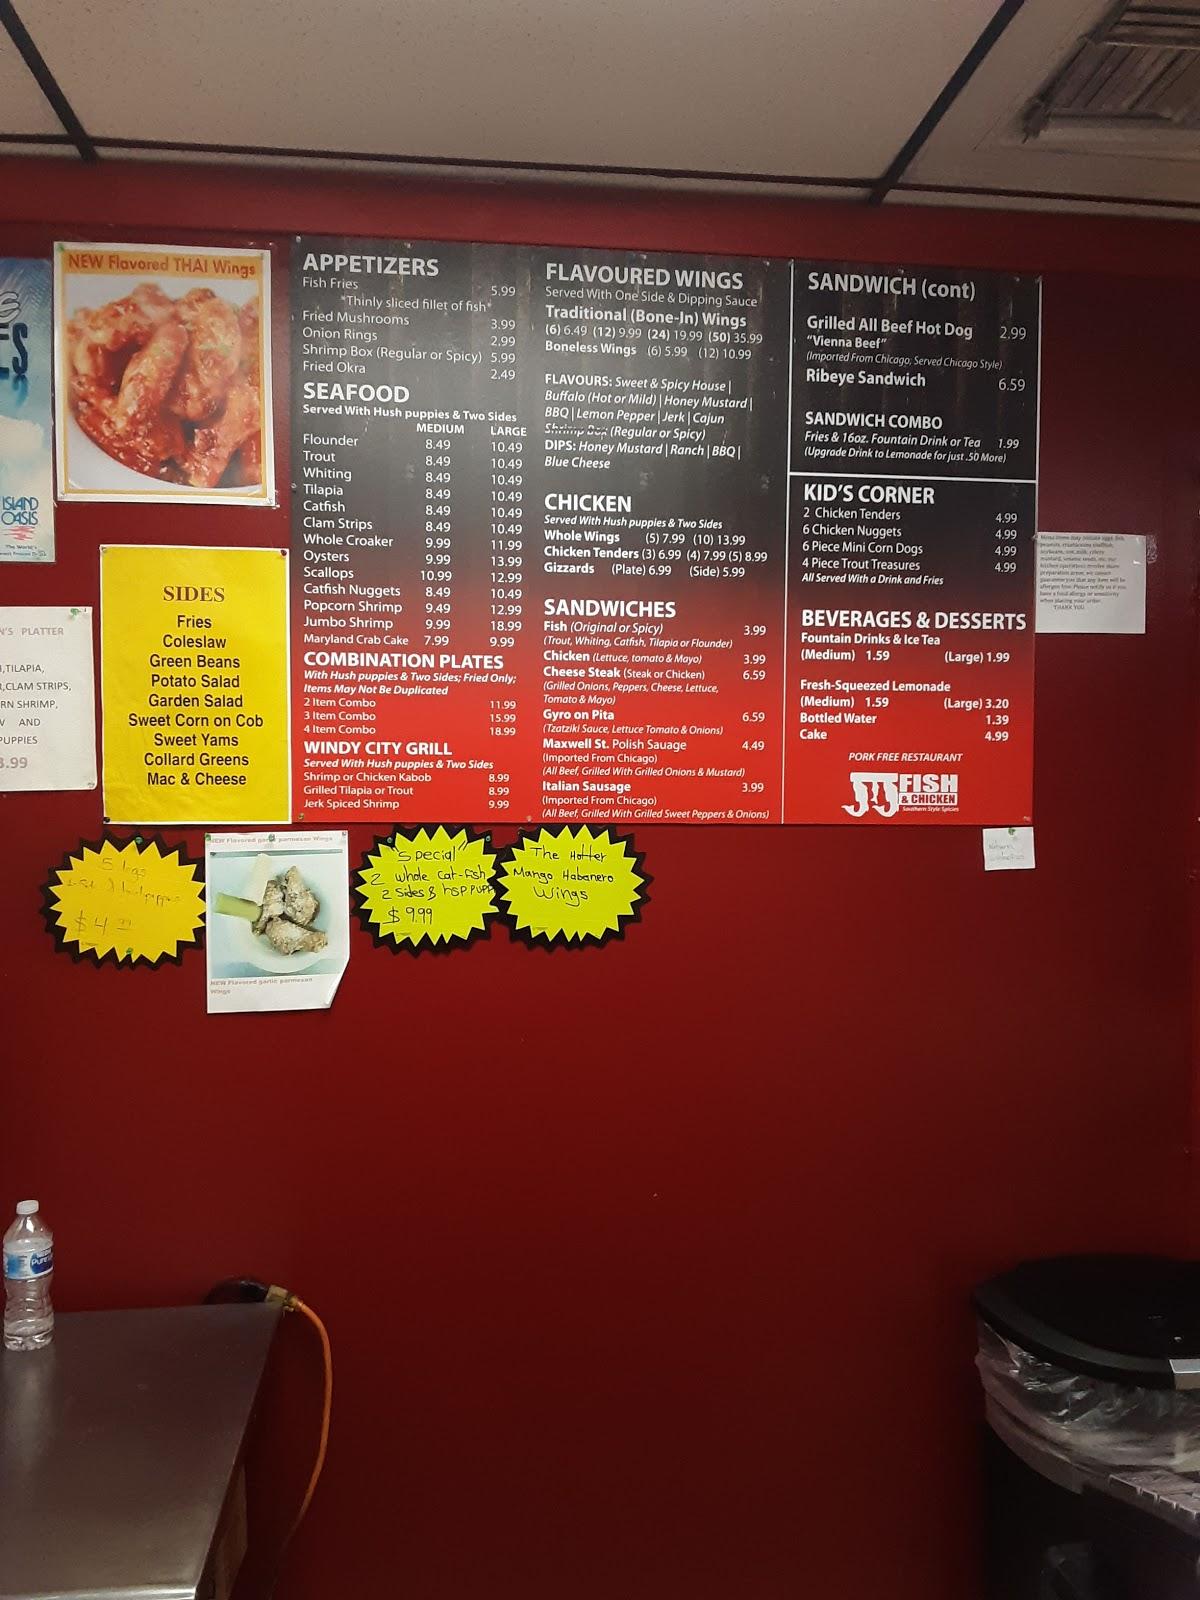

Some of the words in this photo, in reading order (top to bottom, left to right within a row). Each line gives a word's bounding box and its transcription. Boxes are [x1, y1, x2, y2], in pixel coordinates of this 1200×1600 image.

[68, 254, 102, 268] NEW
[108, 256, 168, 271] Flavored
[173, 258, 208, 273] THAI
[212, 259, 256, 278] Wings
[303, 254, 438, 276] APPETIZERS
[547, 263, 670, 286] FLAVOURED
[675, 270, 743, 289] WINGS
[303, 277, 326, 288] Fish
[331, 278, 358, 289] Fries
[492, 286, 515, 296] 5.99
[808, 272, 916, 297] SANDWICH
[922, 279, 975, 301] (cont)
[386, 297, 418, 309] sliced
[423, 299, 448, 310] fillet
[451, 300, 463, 311] of
[546, 305, 626, 321] Traditional
[631, 309, 698, 326] (Bone-In)
[702, 312, 746, 330] Wings
[807, 316, 855, 330] Grilled
[859, 318, 877, 331] All
[882, 319, 913, 333] Beef
[916, 321, 941, 335] Hot
[945, 323, 972, 339] Dog
[1000, 326, 1026, 340] 2.99
[546, 340, 598, 353] Boneless
[601, 343, 636, 357] Wings
[648, 346, 661, 357] (6)
[665, 346, 687, 357] 5.99
[699, 347, 718, 360] (12)
[723, 348, 751, 360] 10.99
[807, 368, 854, 386] Ribeye
[858, 371, 925, 386] Sandwich
[999, 378, 1025, 391] 6.59
[304, 382, 409, 402] SEAFOOD
[806, 412, 885, 427] SANDWICH
[888, 415, 942, 429] COMBO
[417, 423, 464, 434] MEDIUM
[491, 426, 526, 436] LARGE
[304, 434, 358, 446] Flounder
[426, 439, 450, 450] 8.49
[492, 442, 522, 452] 10.49
[805, 484, 853, 502] KID'S
[858, 486, 934, 504] CORNER
[3, 496, 39, 510] ISLAND
[545, 494, 631, 512] CHICKEN
[1, 511, 38, 525] OASIS
[544, 530, 582, 541] Whole
[584, 531, 620, 544] Wings
[646, 533, 659, 544] (5)
[663, 534, 685, 544] 7.99
[694, 534, 713, 545] (10)
[718, 535, 745, 545] 13.99
[803, 524, 810, 534] 6
[812, 524, 854, 535] Chicken
[858, 525, 901, 539] Nuggets
[996, 529, 1016, 539] 4.99
[164, 586, 224, 602] SIDES
[544, 599, 676, 618] SANDWICHES
[178, 615, 212, 628] Fries
[802, 610, 911, 628] BEVERAGES
[916, 612, 930, 628] &
[935, 612, 1026, 630] DESSERTS
[544, 621, 567, 631] Fish
[571, 622, 617, 634] (Original
[632, 623, 663, 636] Spicy)
[744, 626, 766, 635] 3.99
[163, 634, 226, 648] Coleslaw
[150, 654, 191, 667] Green
[197, 655, 240, 668] Beans
[304, 652, 434, 668] COMBINATION
[440, 655, 503, 669] PLATES
[36, 682, 71, 691] STRIPS,
[152, 674, 196, 687] Potato
[202, 674, 239, 688] Salad
[17, 700, 58, 708] SHRIMP,
[149, 694, 199, 707] Garden
[204, 694, 242, 707] Salad
[19, 718, 40, 726] AND
[129, 713, 170, 726] Sweet
[176, 714, 208, 726] Corn
[214, 717, 230, 726] on
[236, 714, 263, 727] Cob
[543, 709, 571, 722] Gyro
[592, 710, 614, 720] Pita
[743, 712, 765, 722] 6.59
[800, 712, 842, 723] Bottled
[844, 713, 877, 723] Water
[986, 715, 1009, 725] 1.39
[154, 733, 196, 746] Sweet
[202, 734, 238, 746] Yams
[800, 729, 827, 739] Cake
[985, 731, 1008, 741] 4.99
[304, 741, 361, 754] WINDY
[365, 742, 402, 754] CITY
[406, 742, 452, 755] GRILL
[144, 753, 194, 765] Collard
[200, 753, 248, 766] Greens
[849, 753, 875, 761] PORK
[877, 753, 899, 761] FREE
[901, 753, 963, 761] RESTAURANT
[148, 772, 175, 785] Mac
[181, 773, 190, 785] &
[195, 772, 246, 785] Cheese
[899, 774, 958, 793] FISH
[304, 785, 337, 794] Grilled
[339, 786, 372, 796] Tilapia
[387, 786, 413, 794] Trout
[489, 787, 509, 795] 8.99
[901, 794, 908, 804] &
[911, 794, 955, 804] CHICKEN
[530, 845, 559, 860] The
